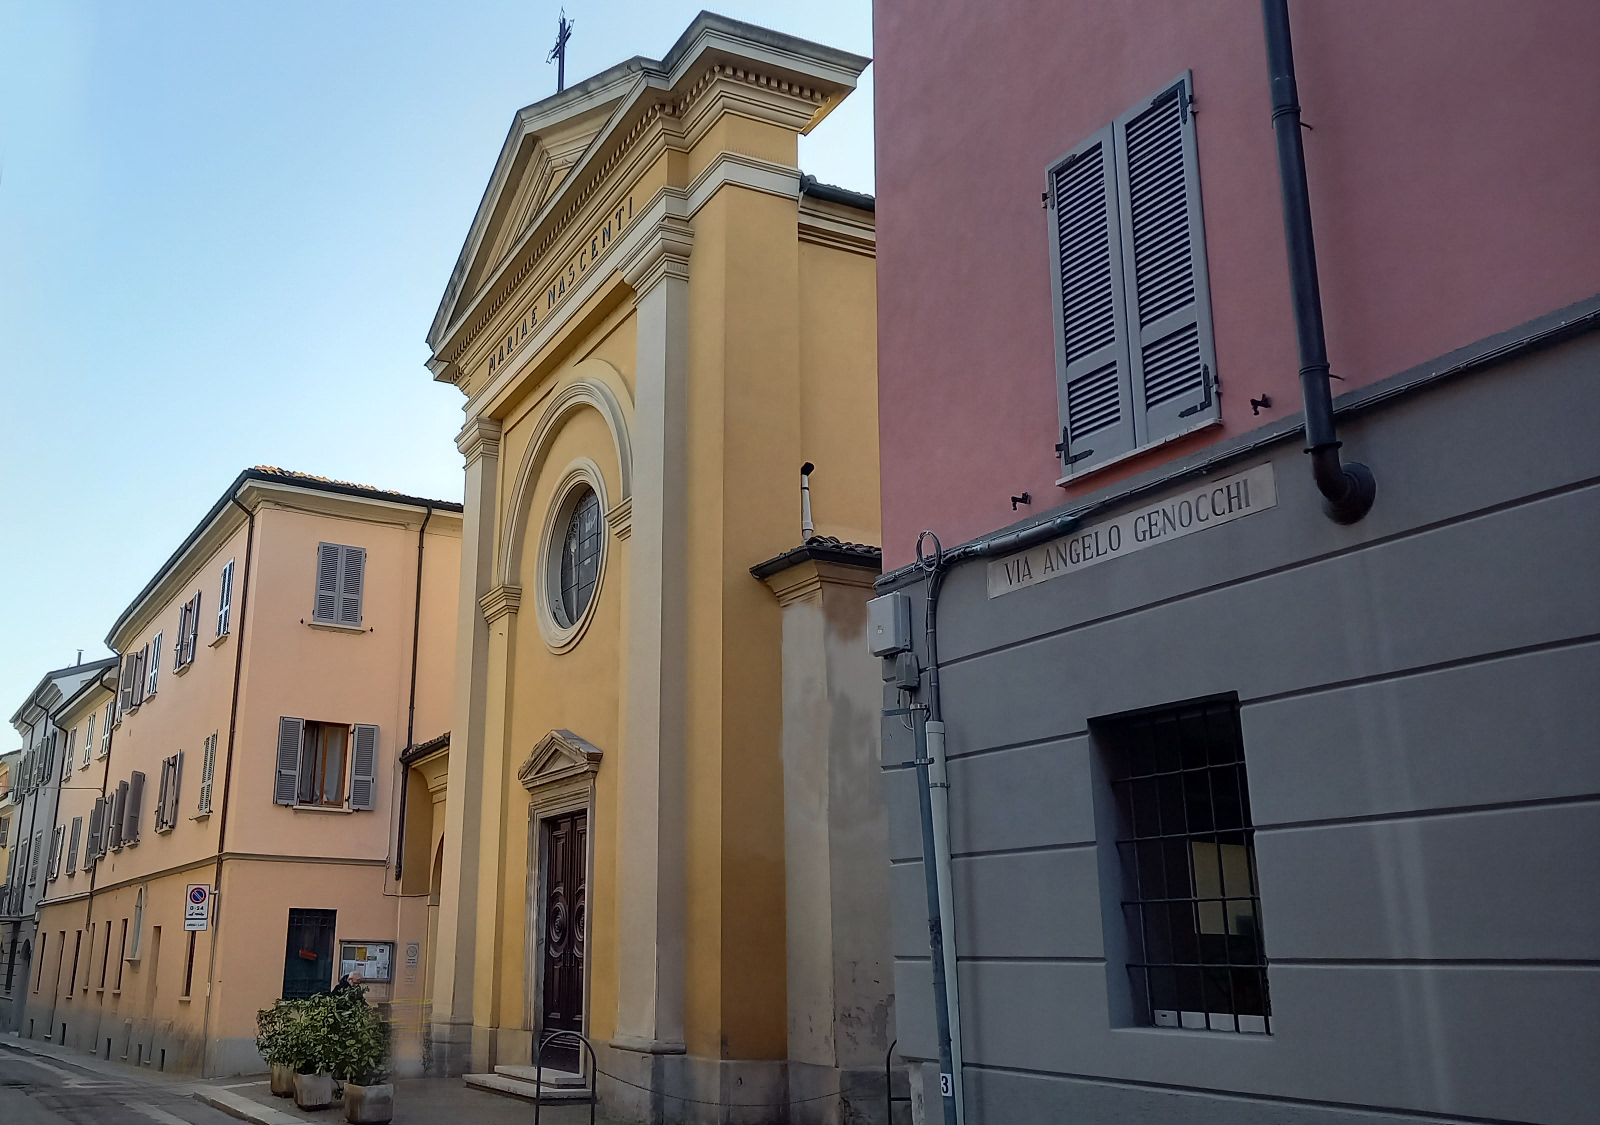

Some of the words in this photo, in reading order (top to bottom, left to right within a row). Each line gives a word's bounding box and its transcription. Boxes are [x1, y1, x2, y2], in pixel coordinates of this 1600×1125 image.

[487, 305, 538, 377] MARIAE
[546, 196, 633, 310] NASCENTI
[1004, 555, 1033, 586] VIA
[1043, 524, 1121, 575] ANGELO
[1134, 478, 1251, 543] GENOCCHI
[941, 1075, 949, 1094] 3
